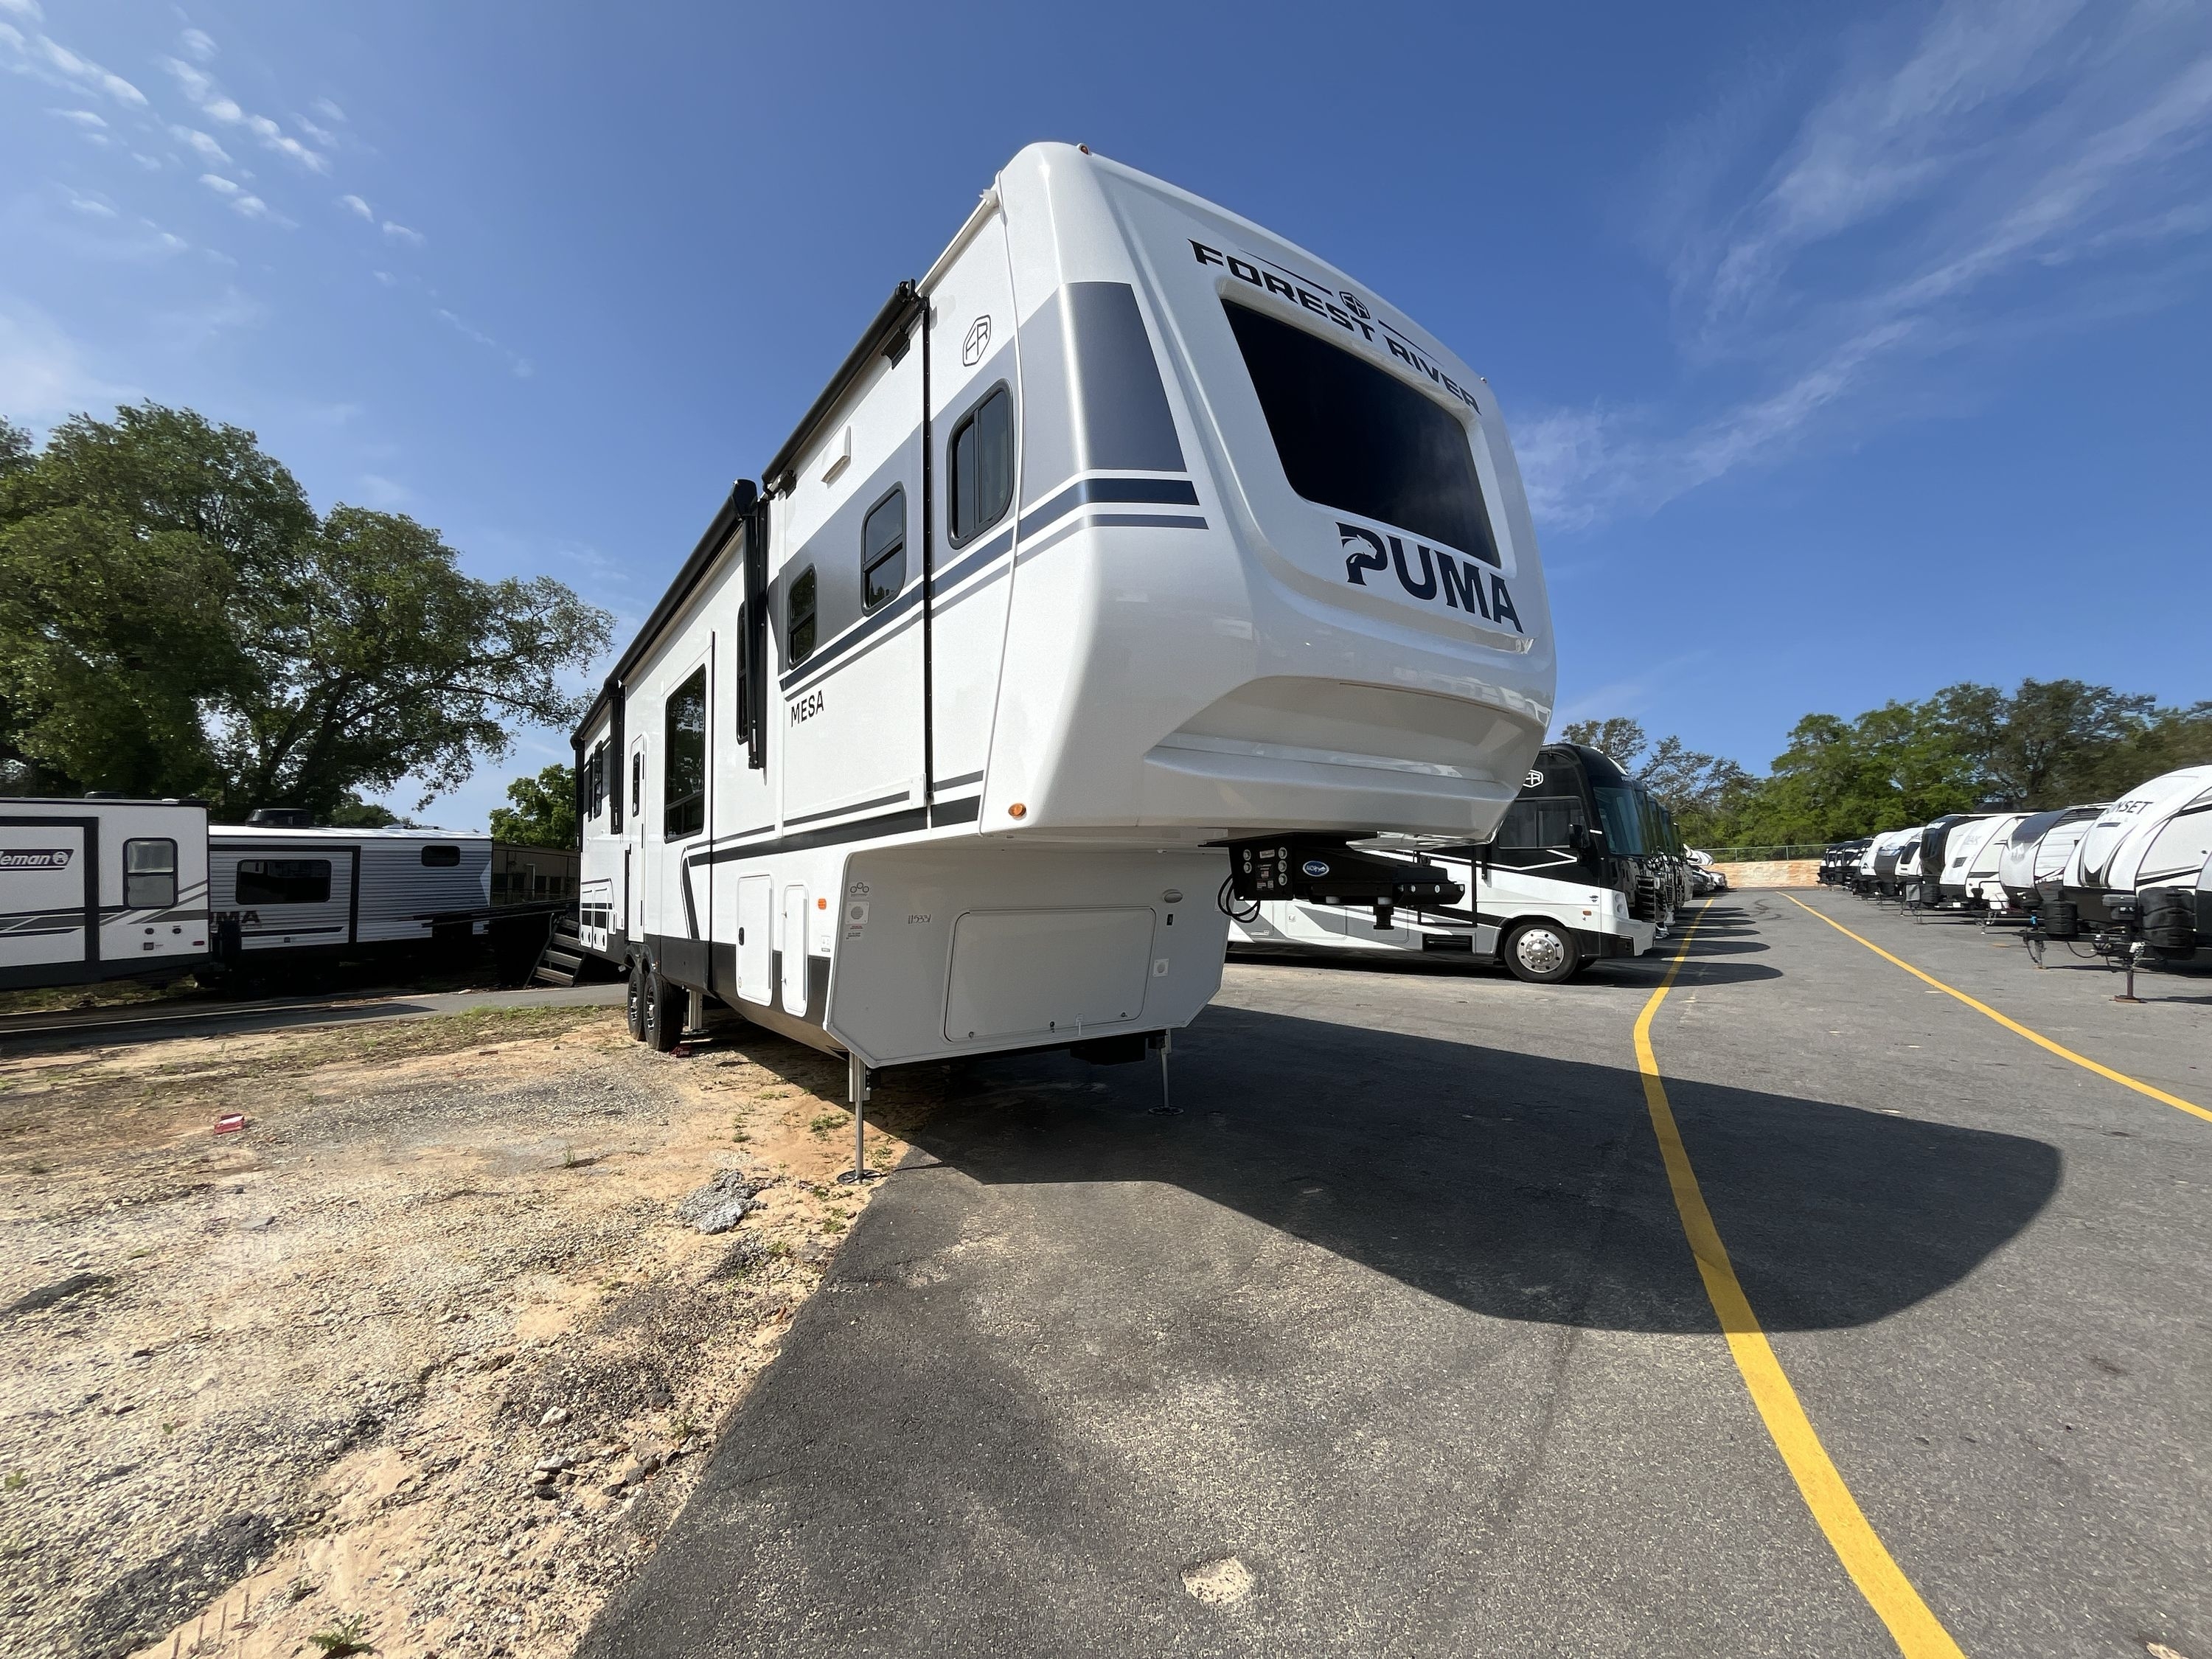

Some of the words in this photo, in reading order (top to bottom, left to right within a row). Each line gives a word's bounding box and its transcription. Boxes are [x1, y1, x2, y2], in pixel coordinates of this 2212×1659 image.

[1187, 238, 1375, 342] FOREST
[1382, 334, 1482, 416] RIVER
[1335, 521, 1524, 634] PUMA
[790, 689, 824, 728] MESA
[2101, 800, 2154, 815] NSET
